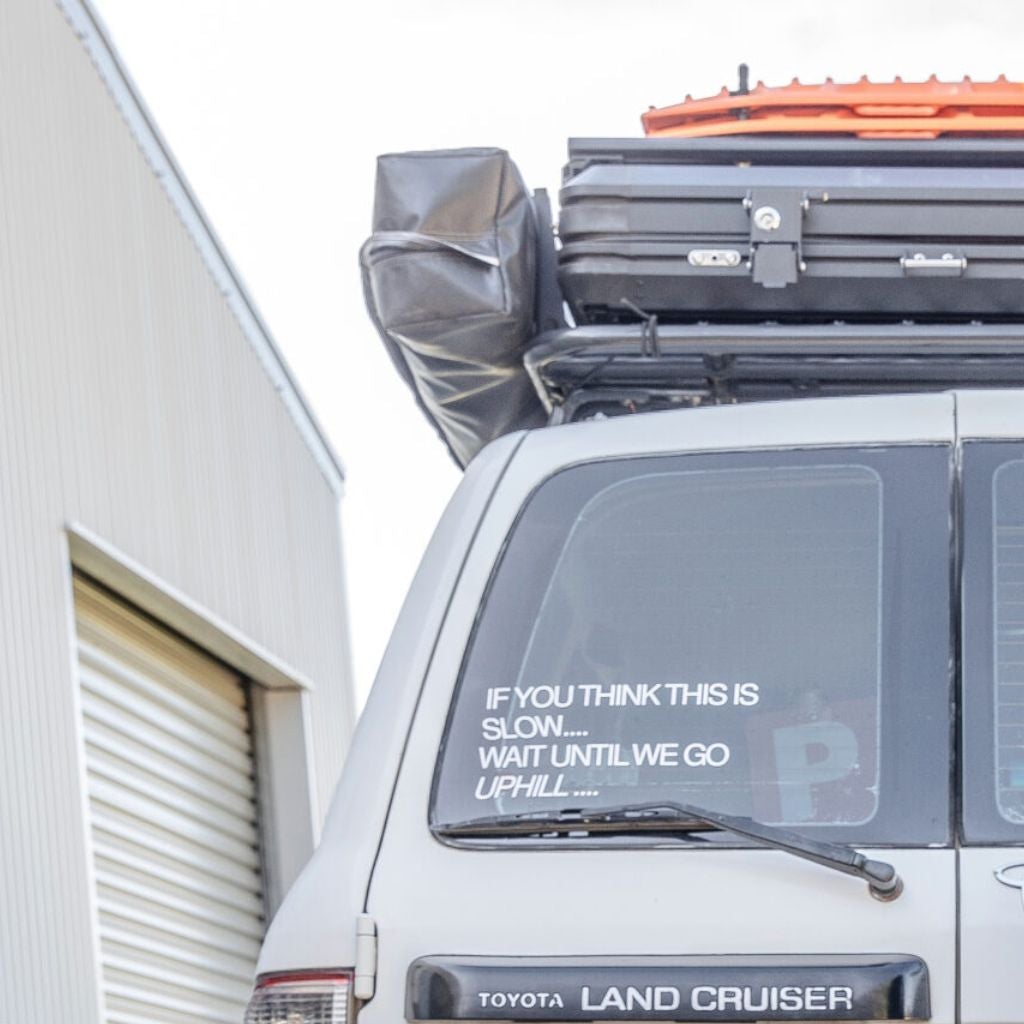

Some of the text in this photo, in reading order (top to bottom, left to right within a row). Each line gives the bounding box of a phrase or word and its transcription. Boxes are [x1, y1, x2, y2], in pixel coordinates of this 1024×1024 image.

[486, 683, 760, 710] IF YOU THINK THIS IS
[482, 715, 588, 740] SLOW....
[478, 743, 730, 769] WAIT UNTIL WE GO
[773, 720, 859, 824] P
[474, 774, 569, 800] UPHILL
[478, 986, 853, 1012] TOYOTA LAND CRUISER
